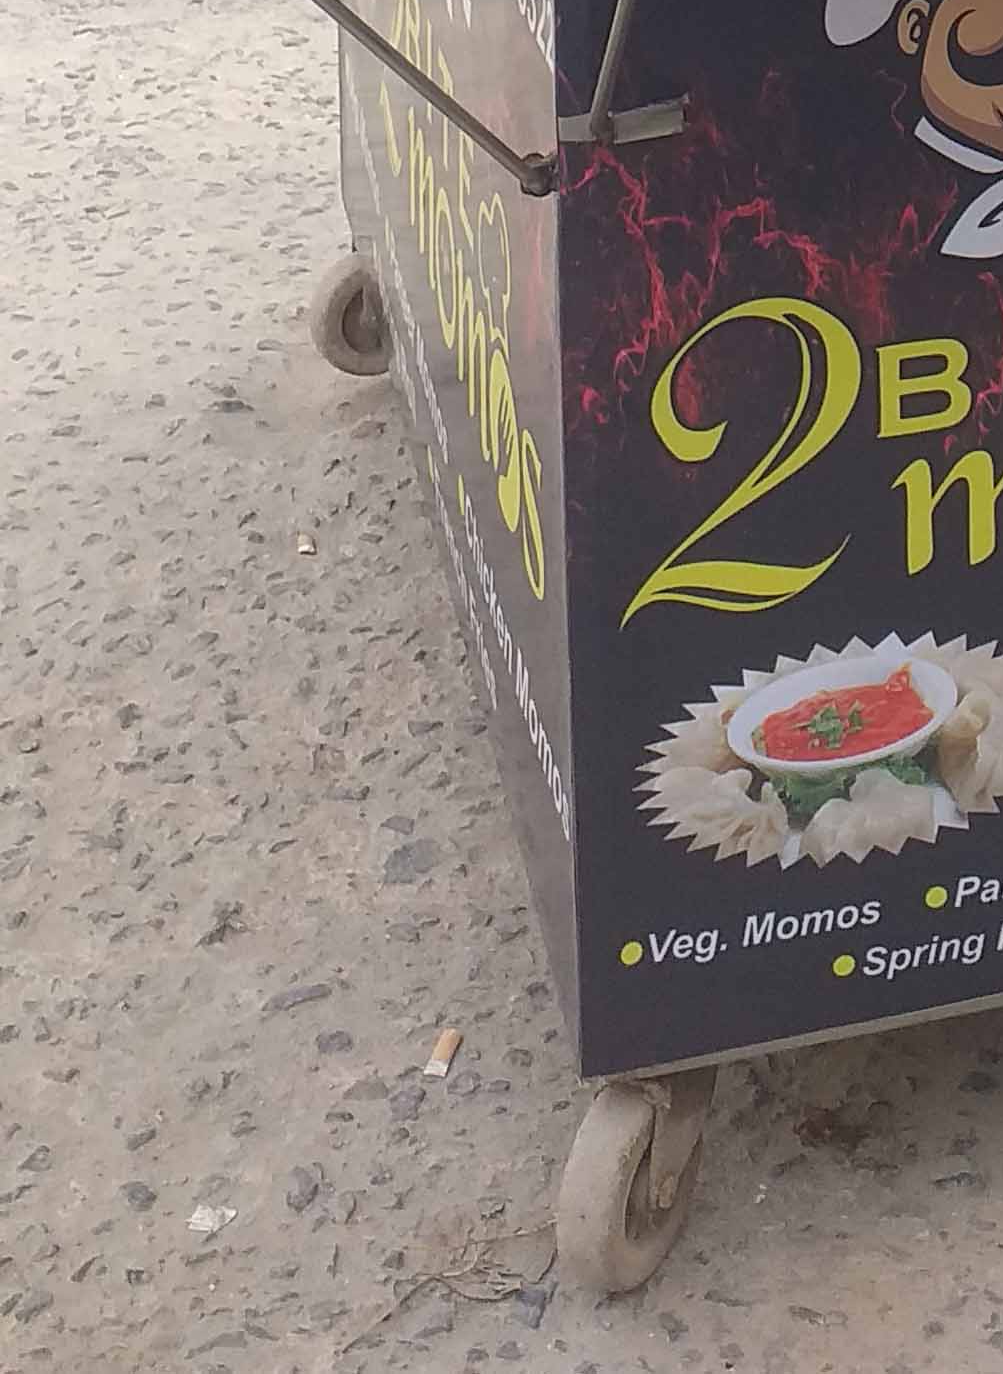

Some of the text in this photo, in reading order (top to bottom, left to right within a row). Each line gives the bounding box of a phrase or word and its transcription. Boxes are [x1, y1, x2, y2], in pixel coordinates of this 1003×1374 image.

[408, 106, 545, 601] momos
[619, 296, 862, 629] 2
[464, 491, 512, 674] Chicken
[516, 647, 571, 842] Momos
[648, 928, 728, 964] Veg.
[741, 899, 882, 948] Momos
[862, 931, 985, 980] Spring
